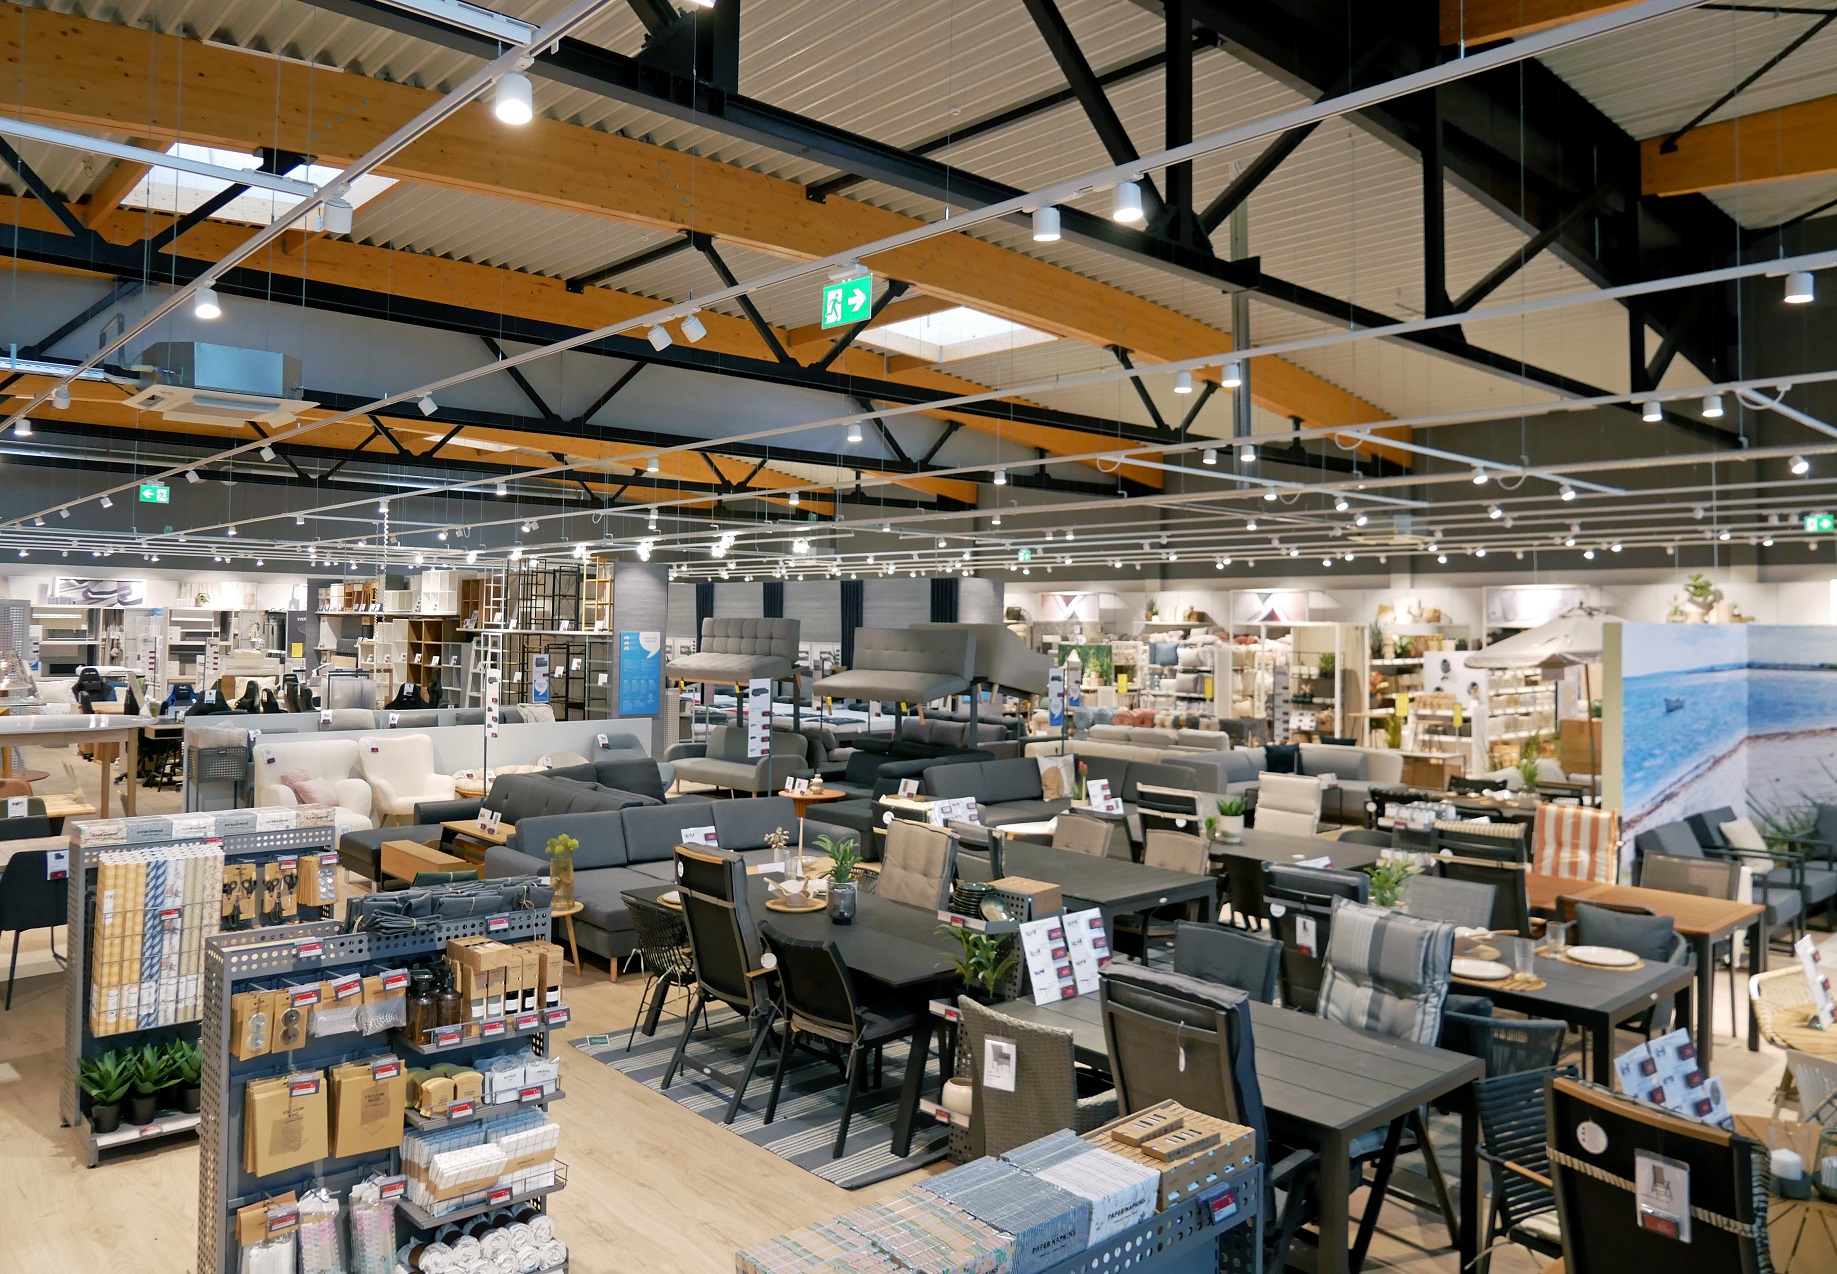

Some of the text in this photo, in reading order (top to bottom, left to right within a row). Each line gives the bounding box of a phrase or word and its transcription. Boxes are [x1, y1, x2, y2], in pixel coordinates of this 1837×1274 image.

[1107, 1208, 1124, 1221] PAPER
[1124, 1199, 1146, 1211] NAPKINS
[1031, 1239, 1051, 1254] PAPER
[1052, 1230, 1076, 1244] NAPKINS
